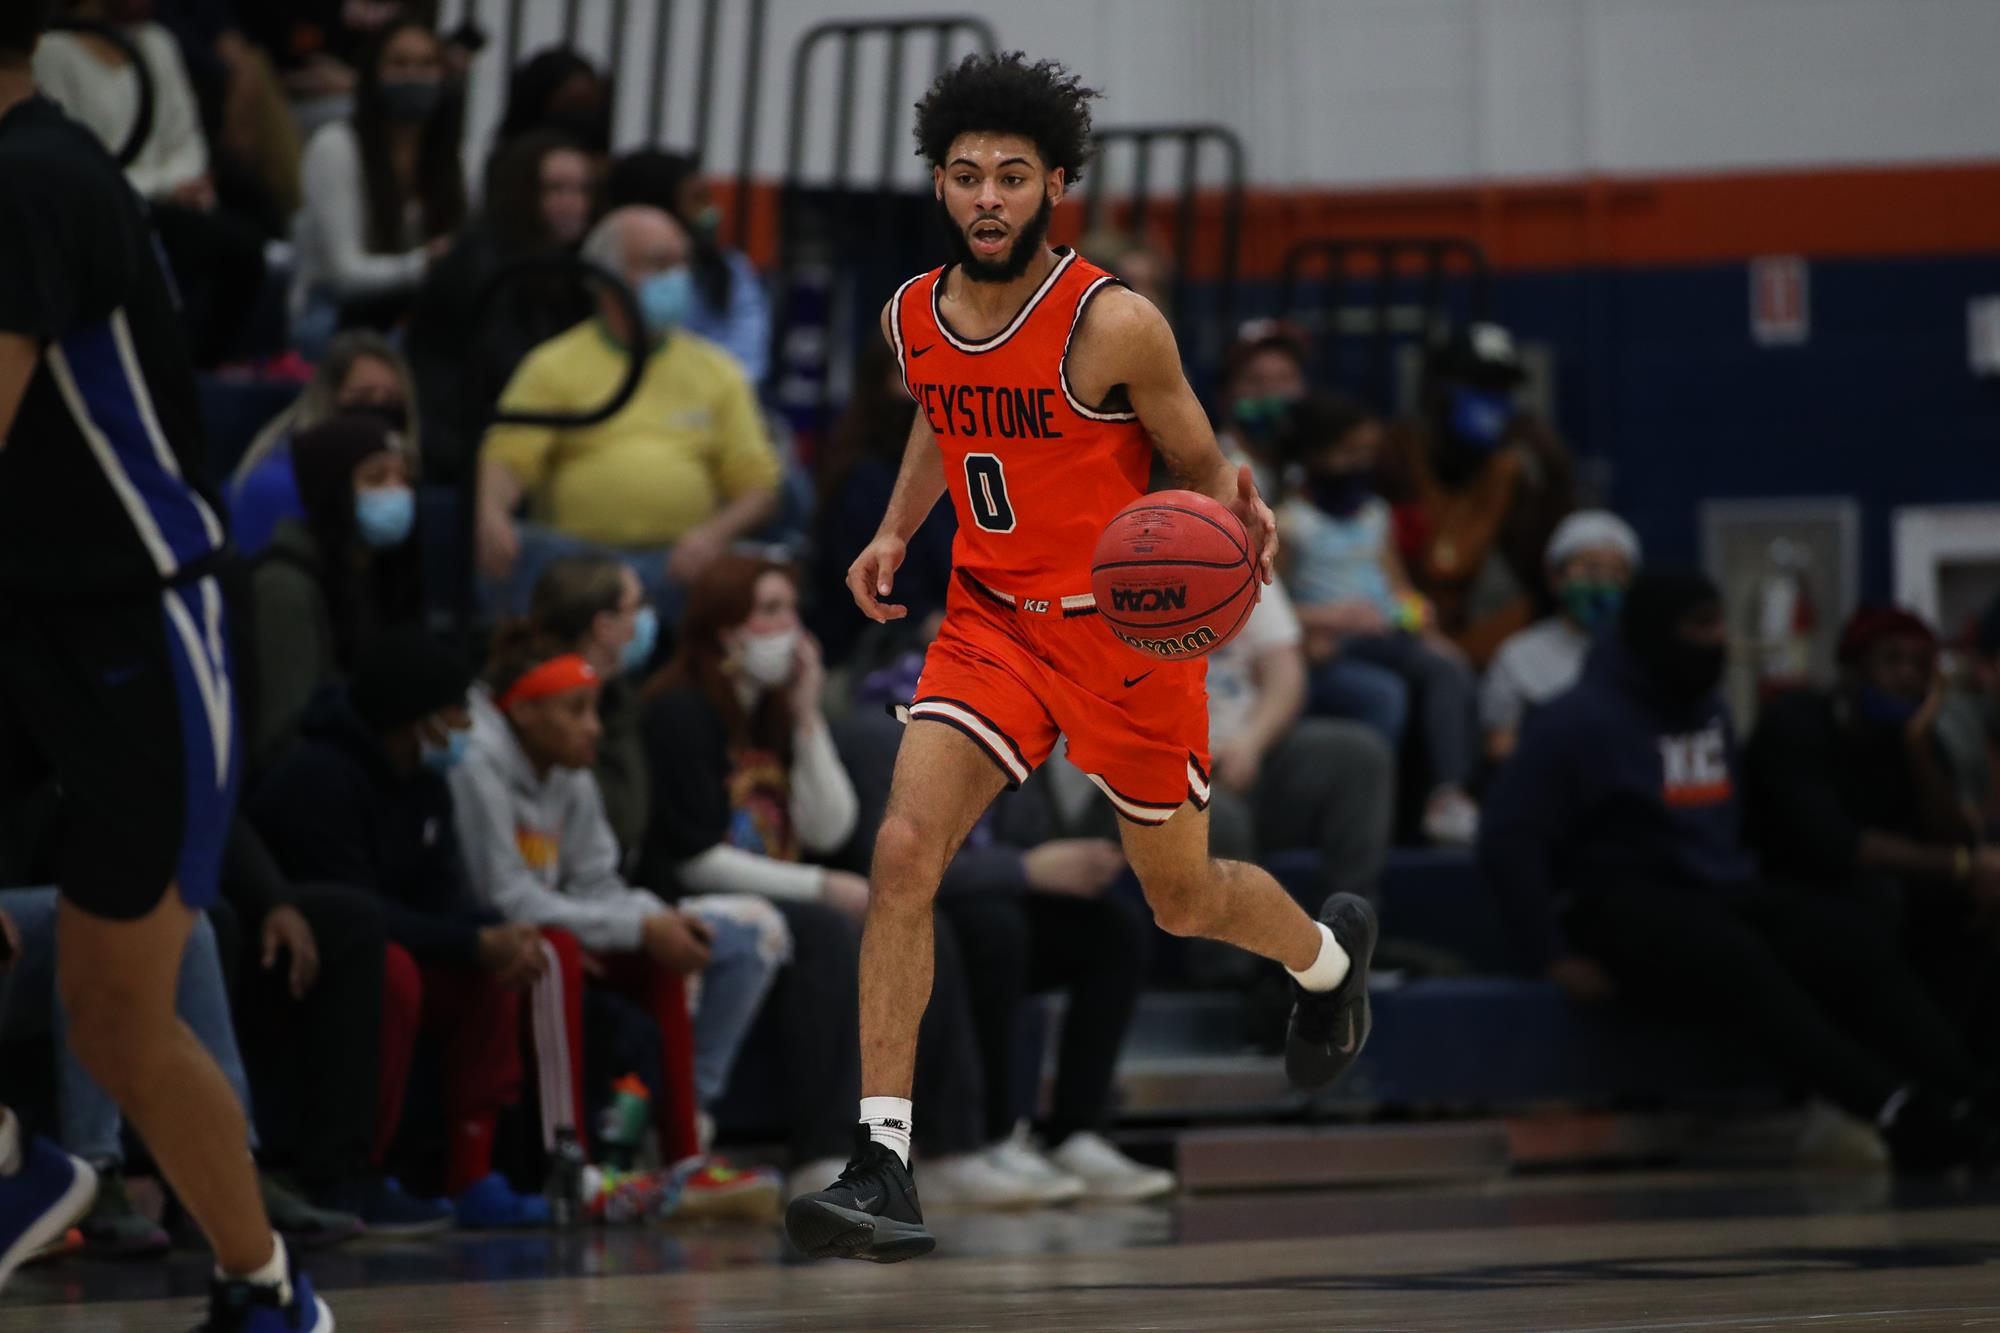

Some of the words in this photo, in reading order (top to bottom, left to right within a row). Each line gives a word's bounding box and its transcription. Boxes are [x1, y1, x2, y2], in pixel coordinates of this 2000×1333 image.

[963, 452, 1016, 534] 0
[1024, 598, 1050, 613] KC
[1111, 585, 1186, 612] NCAA
[1110, 625, 1219, 656] Wilson
[882, 1118, 907, 1130] NIKE
